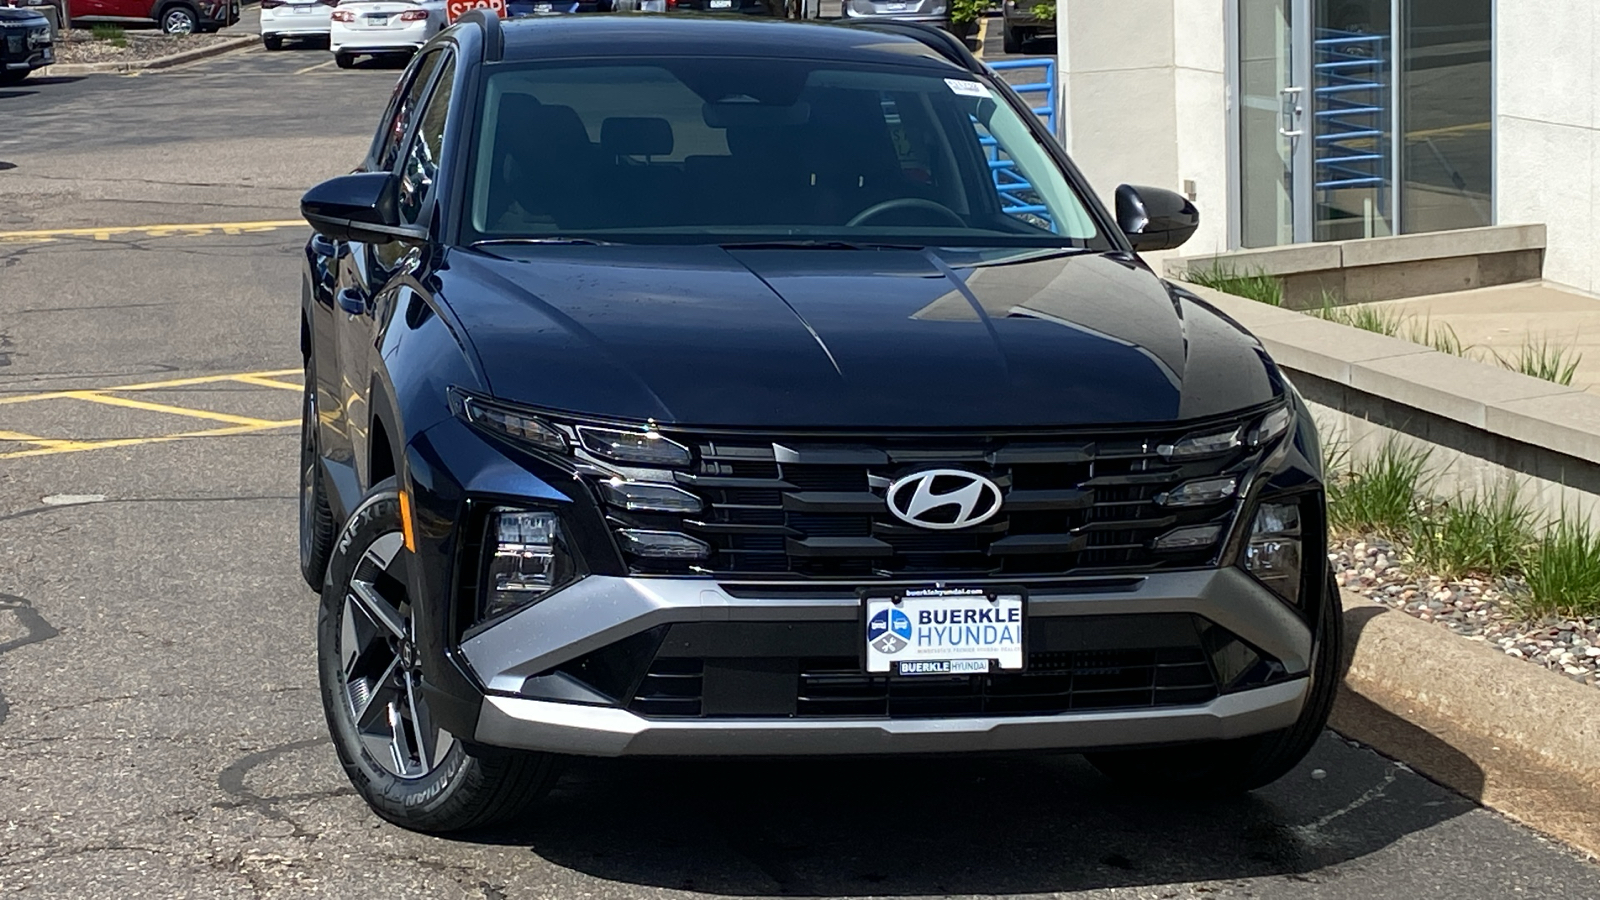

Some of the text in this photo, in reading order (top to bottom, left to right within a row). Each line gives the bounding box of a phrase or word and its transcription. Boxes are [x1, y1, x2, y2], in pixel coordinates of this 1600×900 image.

[919, 608, 1020, 625] BUERKLE
[917, 625, 1020, 647] HYUNDAI
[901, 660, 987, 673] BUERKLE HYUNDAI
